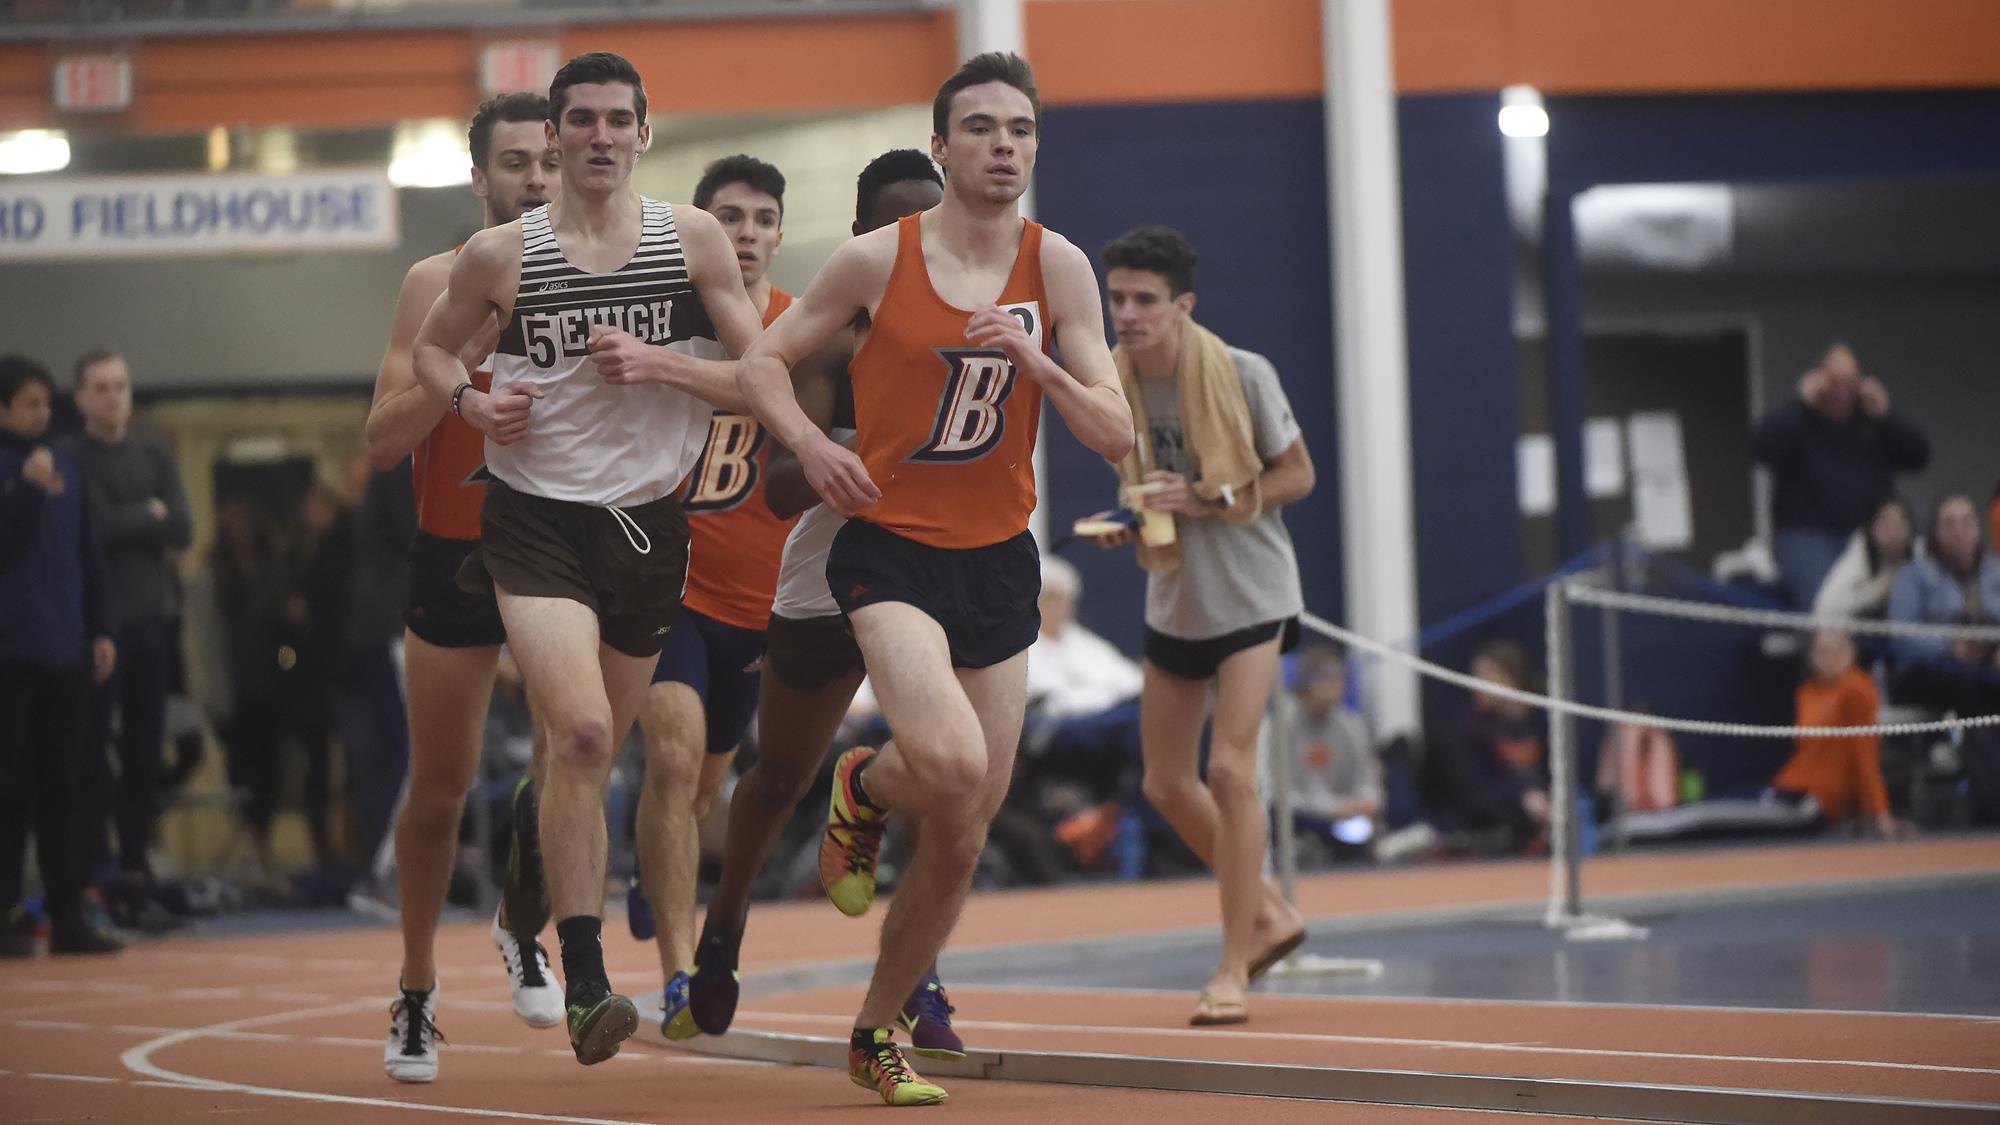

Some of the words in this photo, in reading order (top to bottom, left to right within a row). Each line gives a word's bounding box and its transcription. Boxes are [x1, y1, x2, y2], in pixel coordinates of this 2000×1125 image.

[0, 194, 46, 242] D
[71, 184, 380, 240] FIELDHOUSE
[548, 281, 570, 291] asics
[526, 319, 557, 369] 5
[556, 300, 673, 350] EIGH
[914, 350, 1015, 460] B
[685, 411, 763, 511] B
